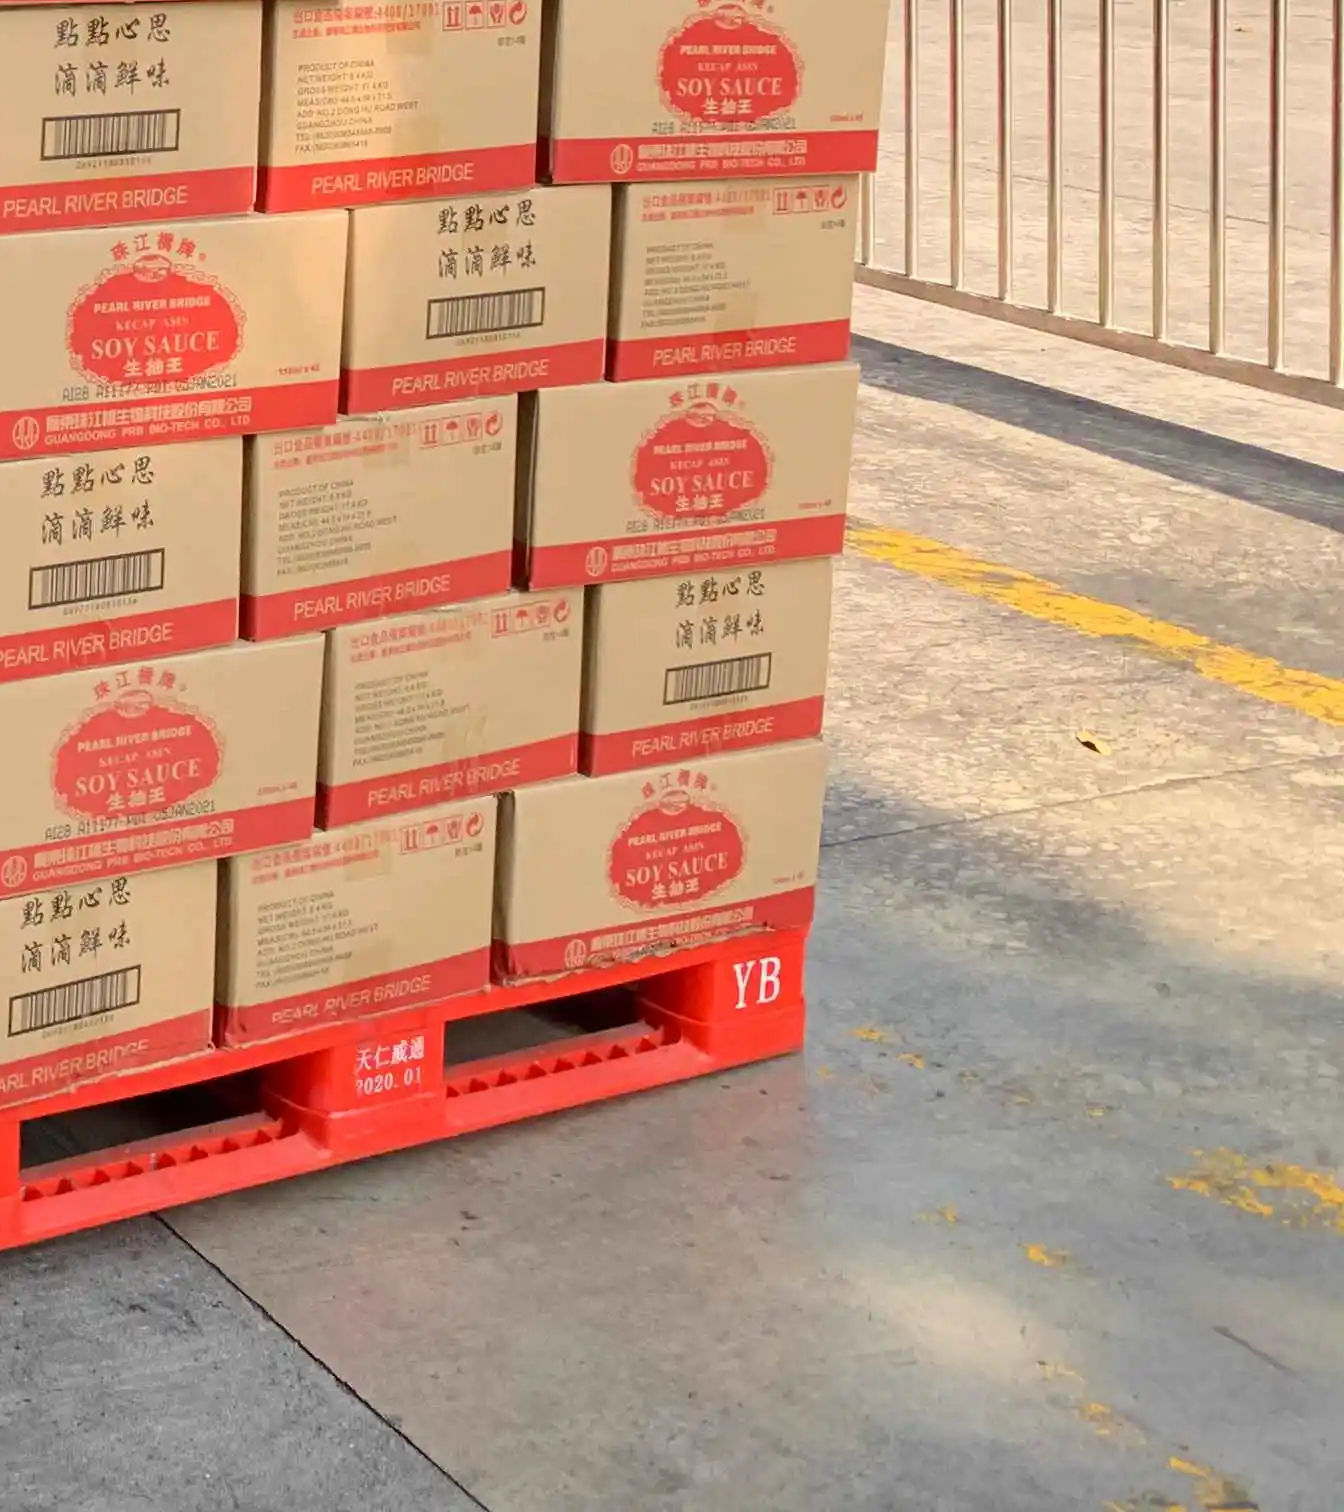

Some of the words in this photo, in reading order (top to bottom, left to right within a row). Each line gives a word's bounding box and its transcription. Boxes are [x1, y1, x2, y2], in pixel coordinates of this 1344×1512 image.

[54, 12, 171, 48] 點點心思
[680, 44, 710, 56] PEARL
[712, 44, 740, 56] RIVER
[742, 44, 776, 56] BRIDGE
[676, 77, 715, 98] SOY
[720, 76, 783, 97] SAUCE
[312, 173, 362, 195] PEARL
[366, 168, 413, 190] RIVER
[417, 163, 473, 185] BRIDGE
[3, 195, 60, 218] PEARL
[65, 191, 118, 213] RIVER
[122, 185, 187, 208] BRIDGE
[437, 198, 535, 235] 點點心思
[93, 300, 130, 316] PEARL
[133, 297, 167, 312] RIVER
[169, 294, 211, 310] BRIDGE
[90, 335, 137, 361] SOY
[144, 328, 220, 357] SAUCE
[653, 346, 698, 366] PEARL
[701, 341, 743, 362] RIVER
[745, 337, 796, 358] BRIDGE
[392, 372, 441, 395] PEARL
[444, 366, 490, 388] RIVER
[493, 358, 549, 381] BRIDGE
[45, 428, 116, 446] GUANGDONG
[653, 443, 682, 457] PEARL
[684, 441, 712, 454] RIVER
[714, 438, 747, 452] BRIDGE
[40, 454, 154, 499] 點點心思
[649, 475, 687, 498] SOY
[692, 468, 753, 493] SAUCE
[294, 594, 343, 620] PEARL
[347, 585, 392, 610] RIVER
[395, 574, 450, 601] BRIDGE
[675, 569, 766, 608] 點點心思
[53, 633, 105, 659] RIVER
[109, 622, 172, 650] BRIDGE
[77, 737, 112, 755] PEARL
[115, 730, 148, 748] RIVER
[151, 723, 192, 742] BRIDGE
[632, 733, 676, 756] PEARL
[679, 725, 721, 747] RIVER
[723, 716, 773, 740] BRIDGE
[75, 770, 120, 798] SOY
[127, 755, 202, 789] SAUCE
[368, 781, 416, 808] PEARL
[419, 770, 463, 796] RIVER
[467, 758, 520, 786] BRIDGE
[627, 832, 656, 849] PEARL
[659, 827, 686, 843] RIVER
[688, 820, 721, 838] BRIDGE
[626, 862, 663, 888] SOY
[668, 849, 729, 880] SAUCE
[21, 875, 130, 930] 點點心思
[270, 1000, 321, 1028] PEARL
[324, 988, 371, 1015] RIVER
[374, 974, 430, 1003] BRIDGE
[732, 955, 782, 1011] YB
[31, 1055, 82, 1084] RIVER
